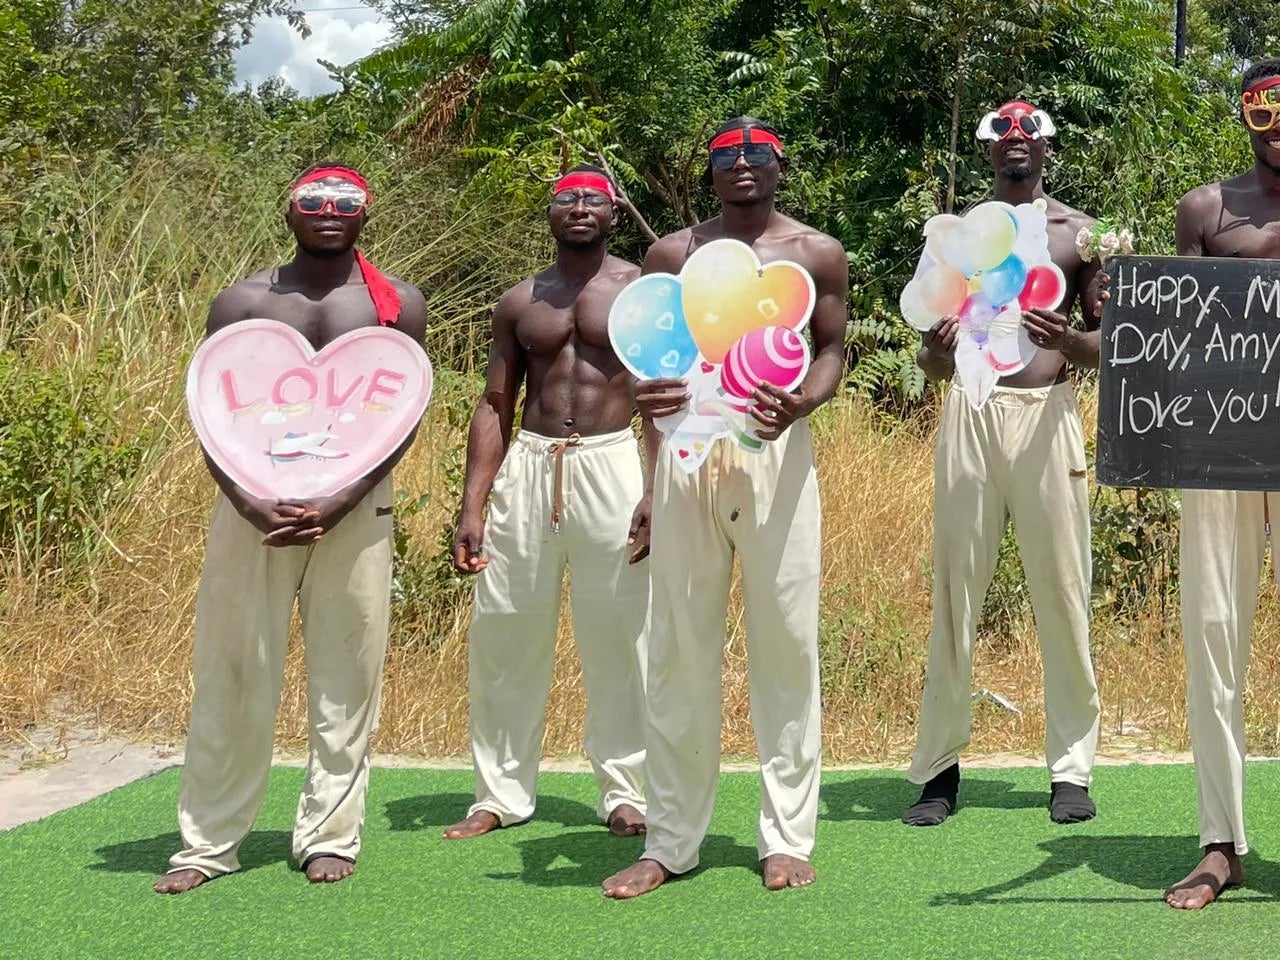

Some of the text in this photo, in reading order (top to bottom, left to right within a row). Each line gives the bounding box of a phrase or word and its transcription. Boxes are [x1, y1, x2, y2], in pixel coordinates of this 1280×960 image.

[1116, 264, 1220, 328] Happy
[1108, 322, 1193, 372] Day,
[219, 366, 408, 415] LOVE
[1117, 377, 1194, 436] love
